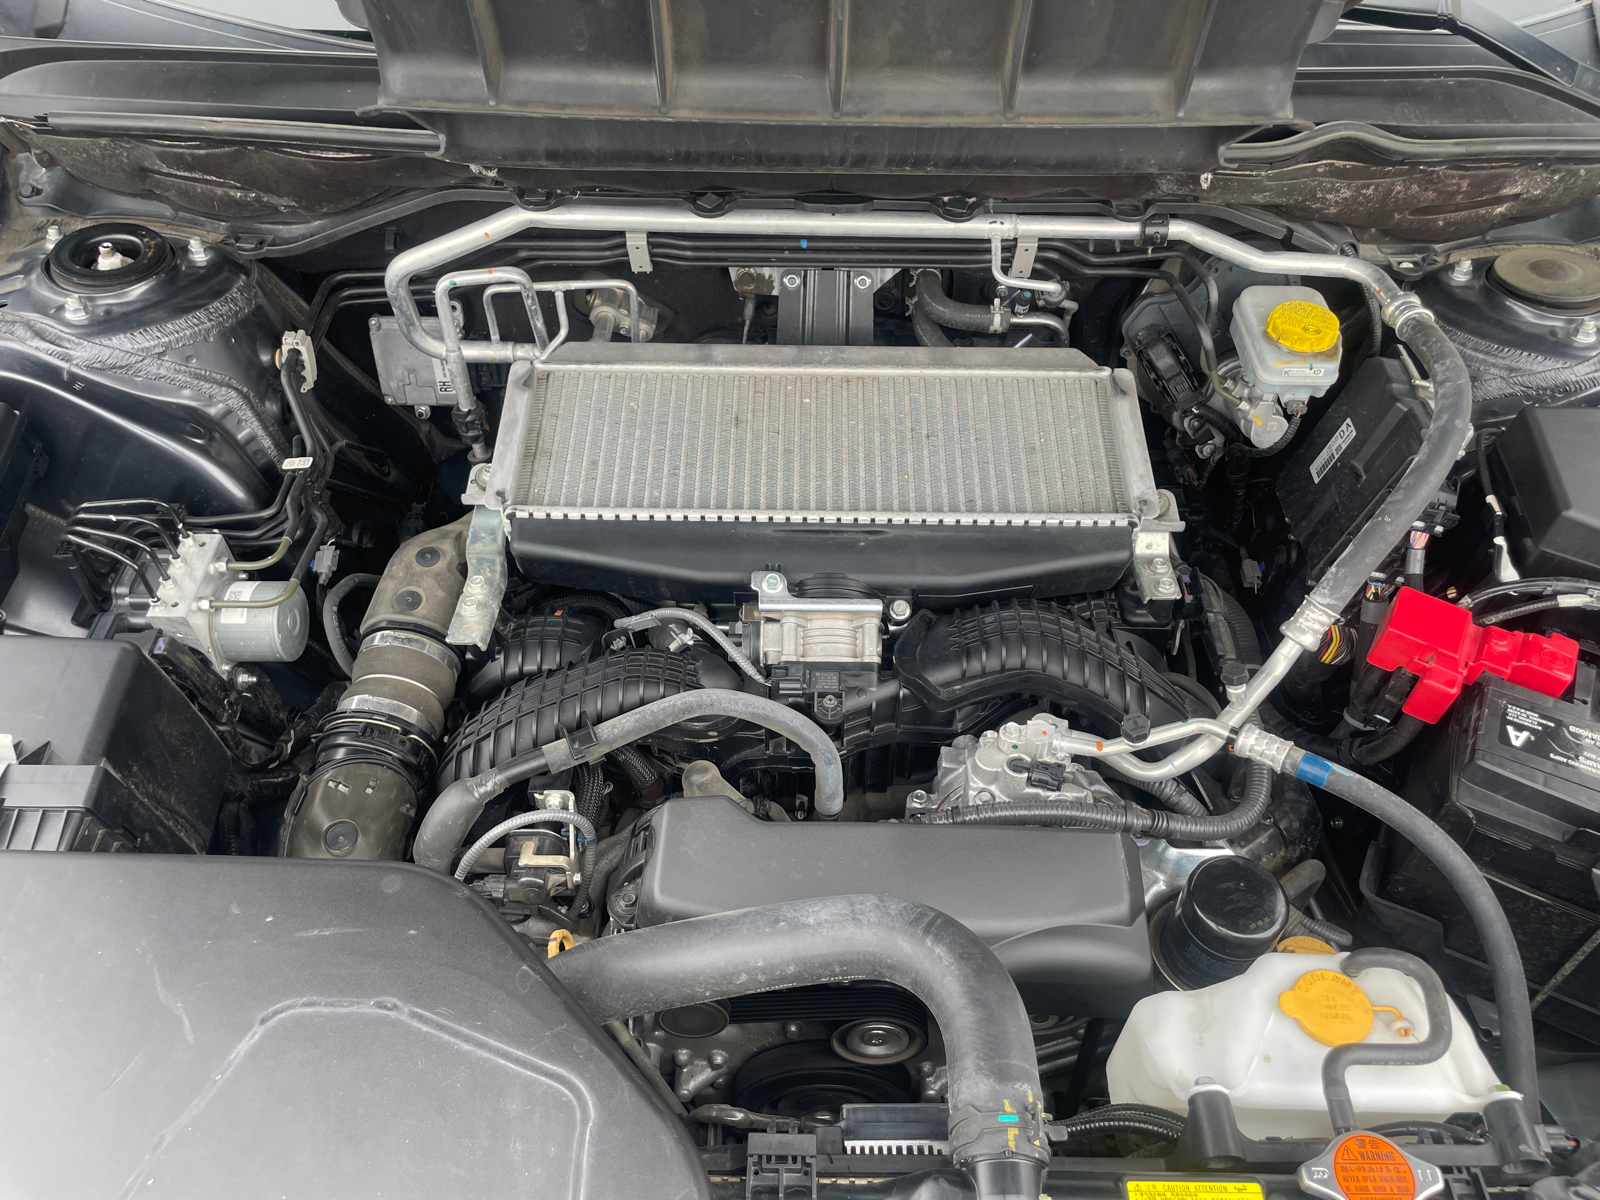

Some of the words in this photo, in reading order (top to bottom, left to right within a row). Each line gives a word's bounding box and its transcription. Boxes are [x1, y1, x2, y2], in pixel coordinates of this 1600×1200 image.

[438, 381, 453, 392] RH
[1550, 753, 1567, 762] AMPS
[1298, 972, 1360, 995] COOLANT
[1359, 1150, 1396, 1162] WARNING
[1341, 1175, 1361, 1183] NEVER
[1361, 1175, 1377, 1183] OPEN
[1162, 1184, 1190, 1192] CAUTION
[1194, 1184, 1228, 1193] ATTENTION
